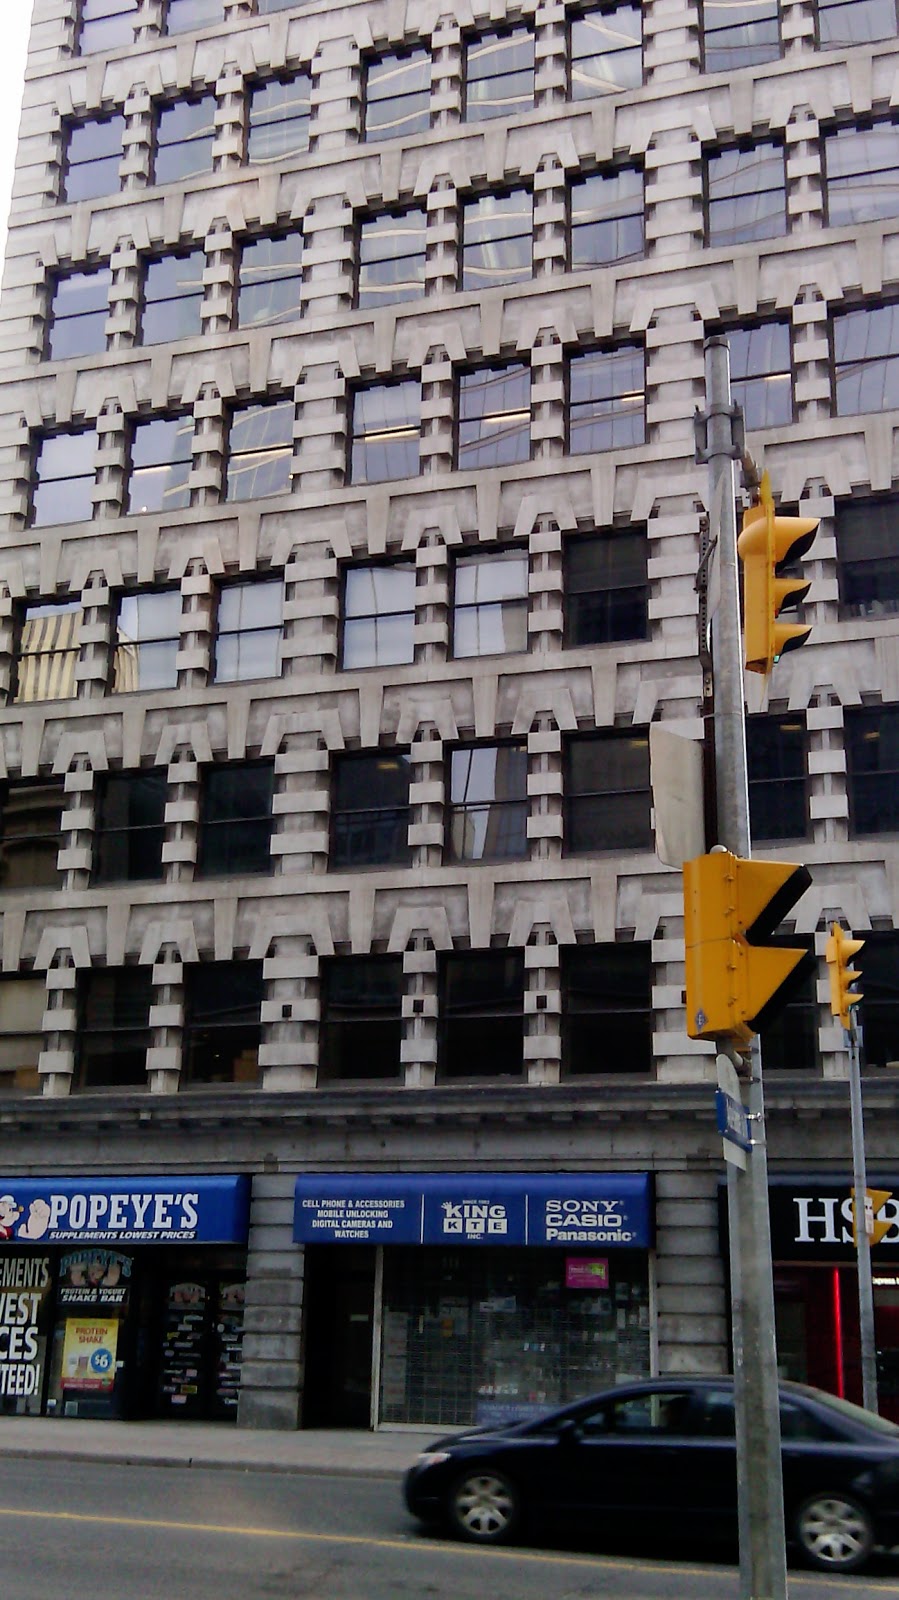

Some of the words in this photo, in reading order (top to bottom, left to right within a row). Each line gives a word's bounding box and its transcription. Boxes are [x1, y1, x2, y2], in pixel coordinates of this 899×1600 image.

[302, 1200, 320, 1208] CELL
[321, 1200, 346, 1208] PHONE
[348, 1200, 353, 1208] &
[355, 1200, 405, 1208] ACCESSORIES
[546, 1200, 619, 1212] SONY
[48, 1193, 198, 1229] POPEYE'S
[317, 1210, 344, 1218] MOBILE
[346, 1210, 388, 1218] UNLOCKING
[445, 1204, 506, 1218] KING
[312, 1220, 340, 1228] DIGITAL
[341, 1220, 376, 1228] CAMERAS
[377, 1220, 393, 1228] AND
[546, 1214, 622, 1227] CASIO
[50, 1231, 118, 1239] SUPPLEMENTS
[119, 1231, 158, 1239] LOWEST
[160, 1231, 196, 1239] PRICES
[334, 1230, 369, 1238] WATCHES
[546, 1228, 632, 1241] Panasonic
[75, 1327, 108, 1335] PROTEIN
[94, 1354, 108, 1368] $6
